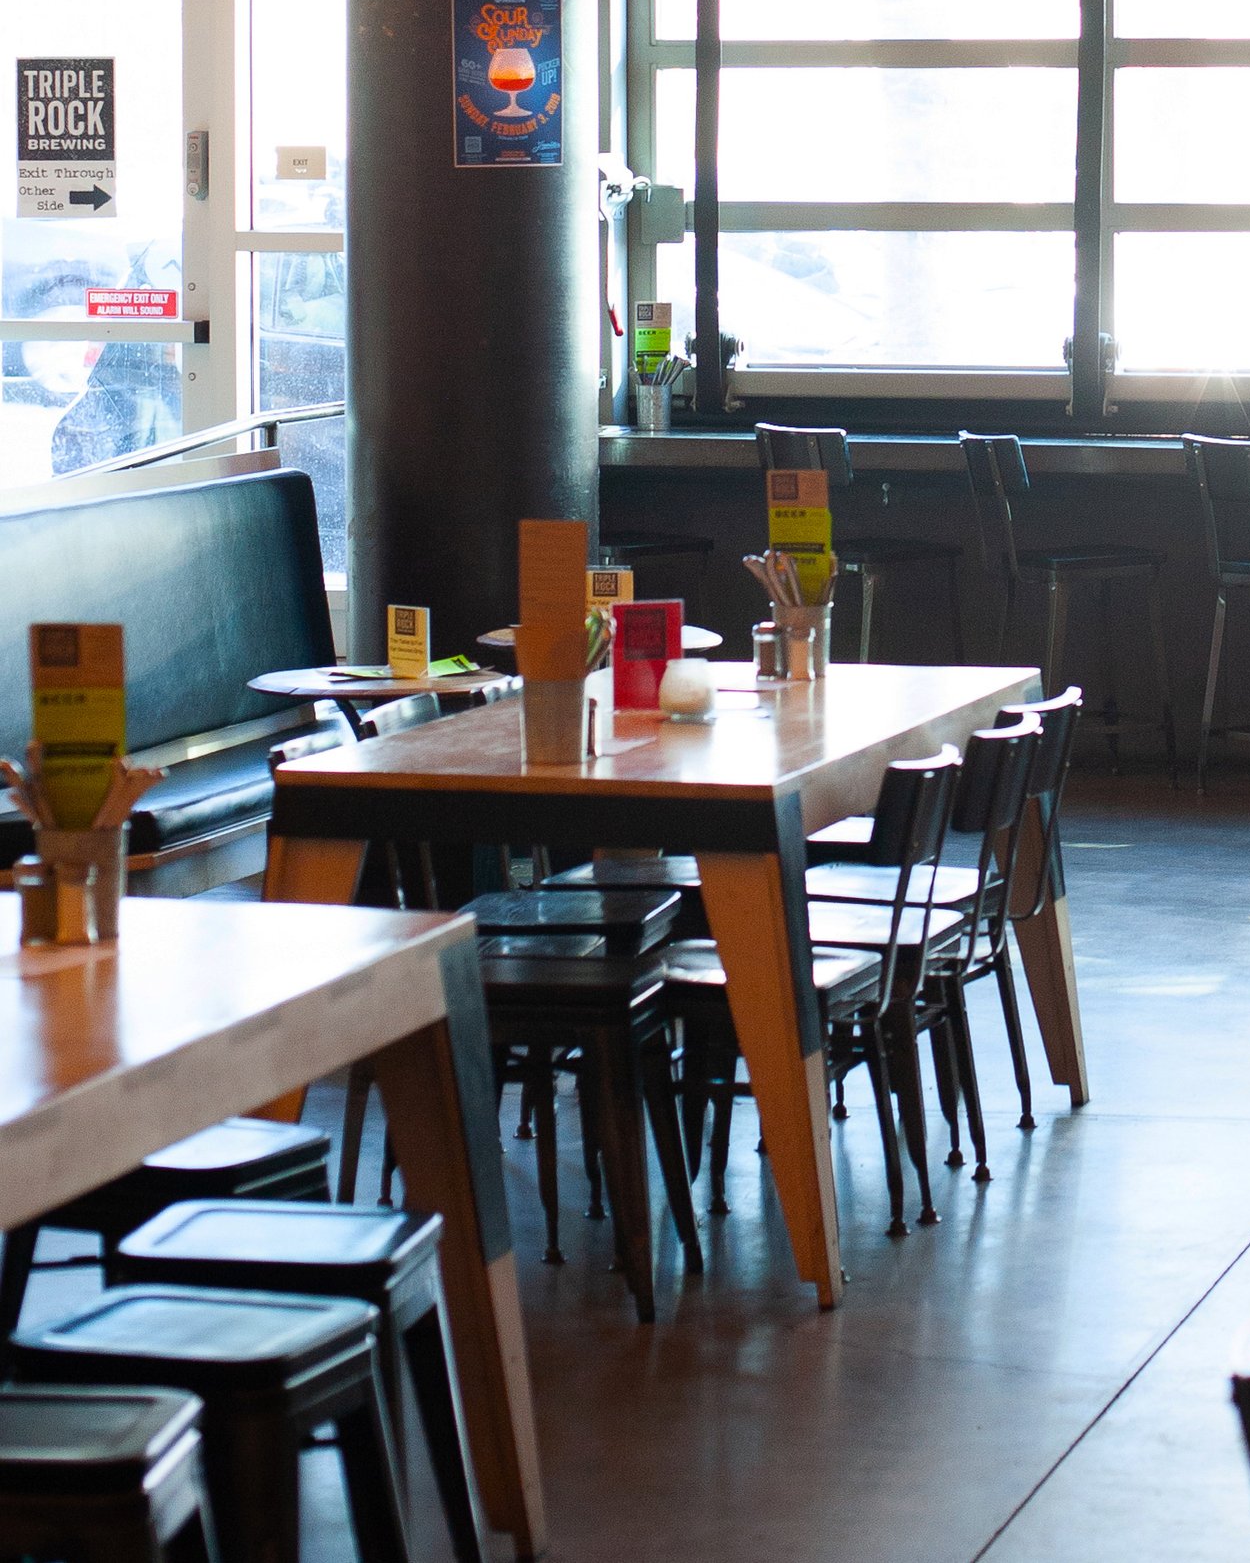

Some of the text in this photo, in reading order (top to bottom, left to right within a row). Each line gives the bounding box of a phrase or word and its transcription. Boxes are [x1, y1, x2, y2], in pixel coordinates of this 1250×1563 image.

[541, 68, 558, 86] UP!
[23, 70, 105, 98] TRIPLE
[28, 100, 105, 136] ROCK
[27, 139, 106, 150] BREWING
[19, 167, 113, 181] Exit Through
[19, 186, 56, 196] Other
[37, 200, 64, 211] Side
[89, 292, 169, 304] EMERGENCY EXIT ONLY
[122, 306, 139, 315] WILL
